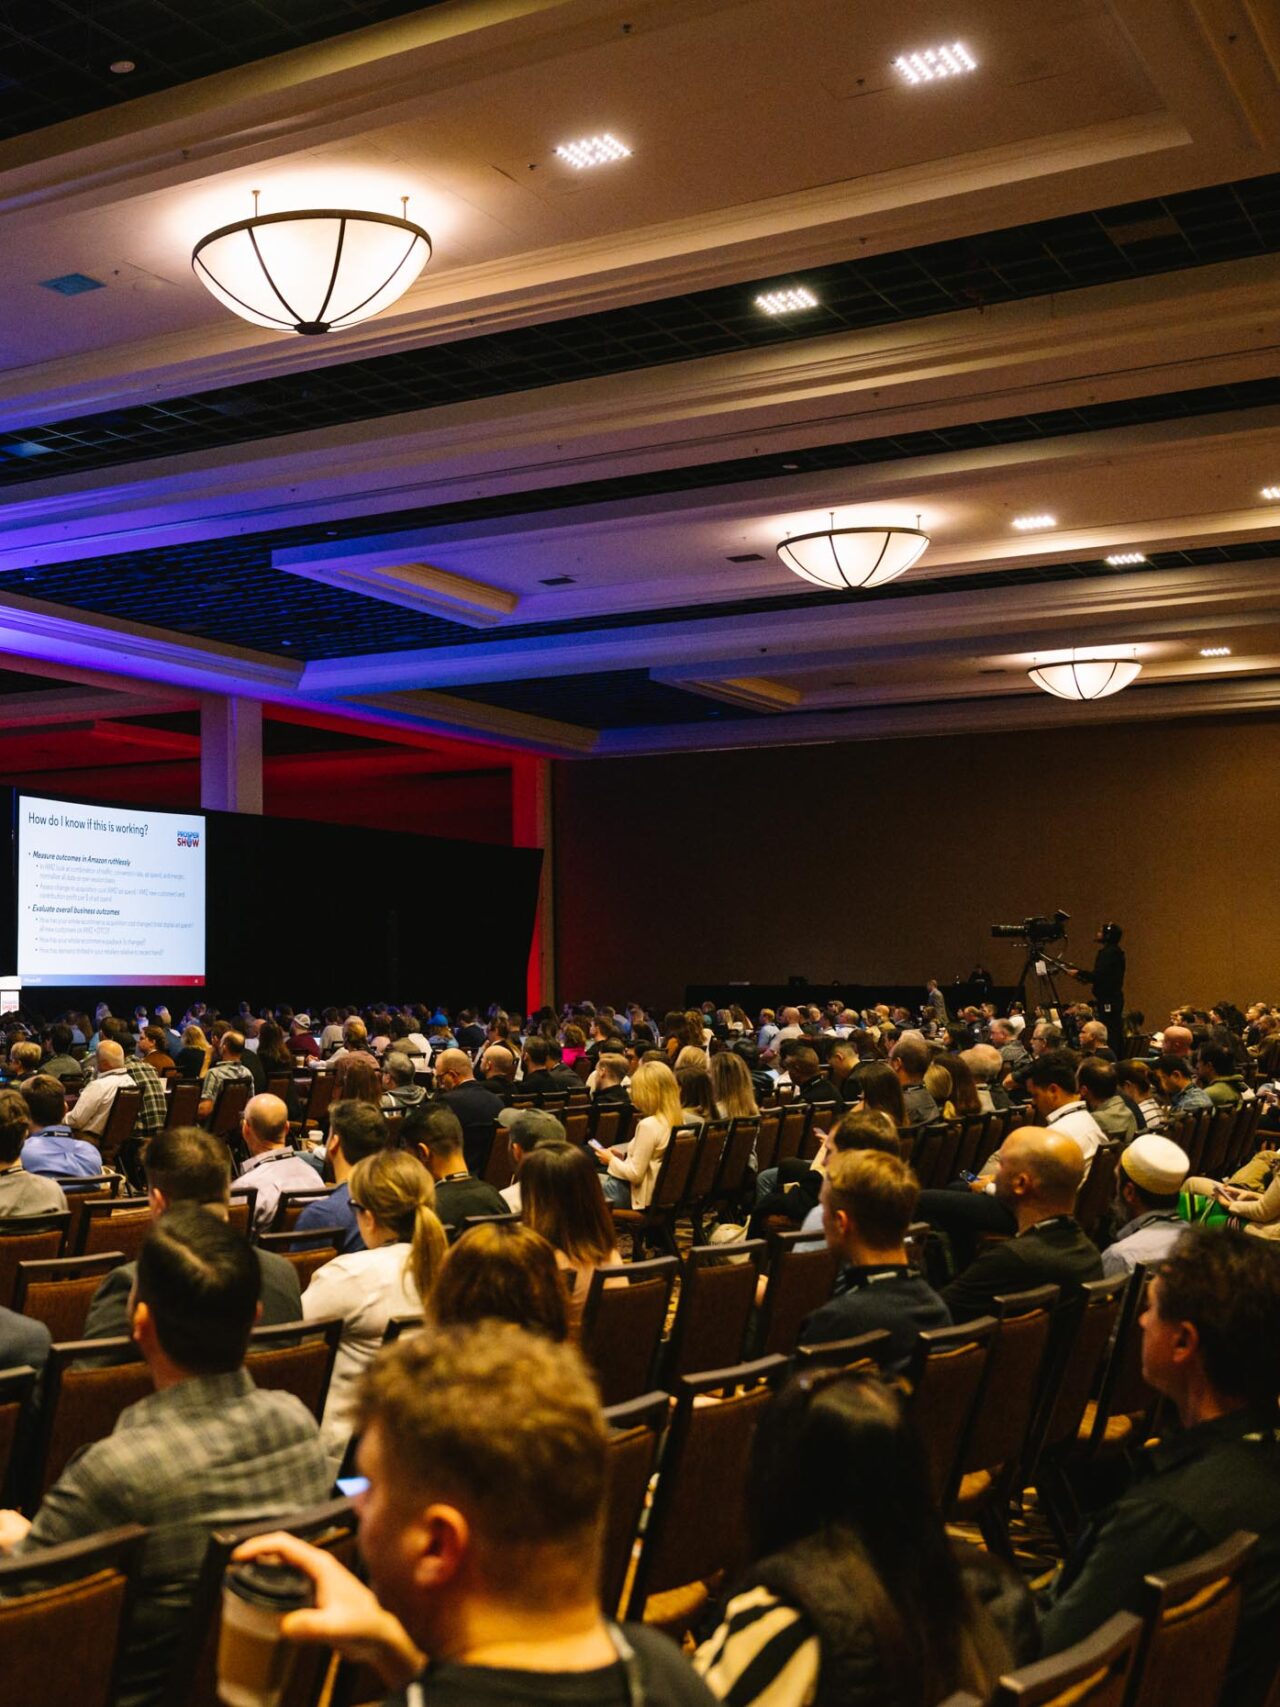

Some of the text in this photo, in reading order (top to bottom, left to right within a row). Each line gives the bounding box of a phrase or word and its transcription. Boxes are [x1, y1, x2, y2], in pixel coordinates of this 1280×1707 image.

[28, 812, 46, 825] How
[65, 816, 86, 829] know
[93, 820, 107, 831] this
[116, 823, 148, 837] working?
